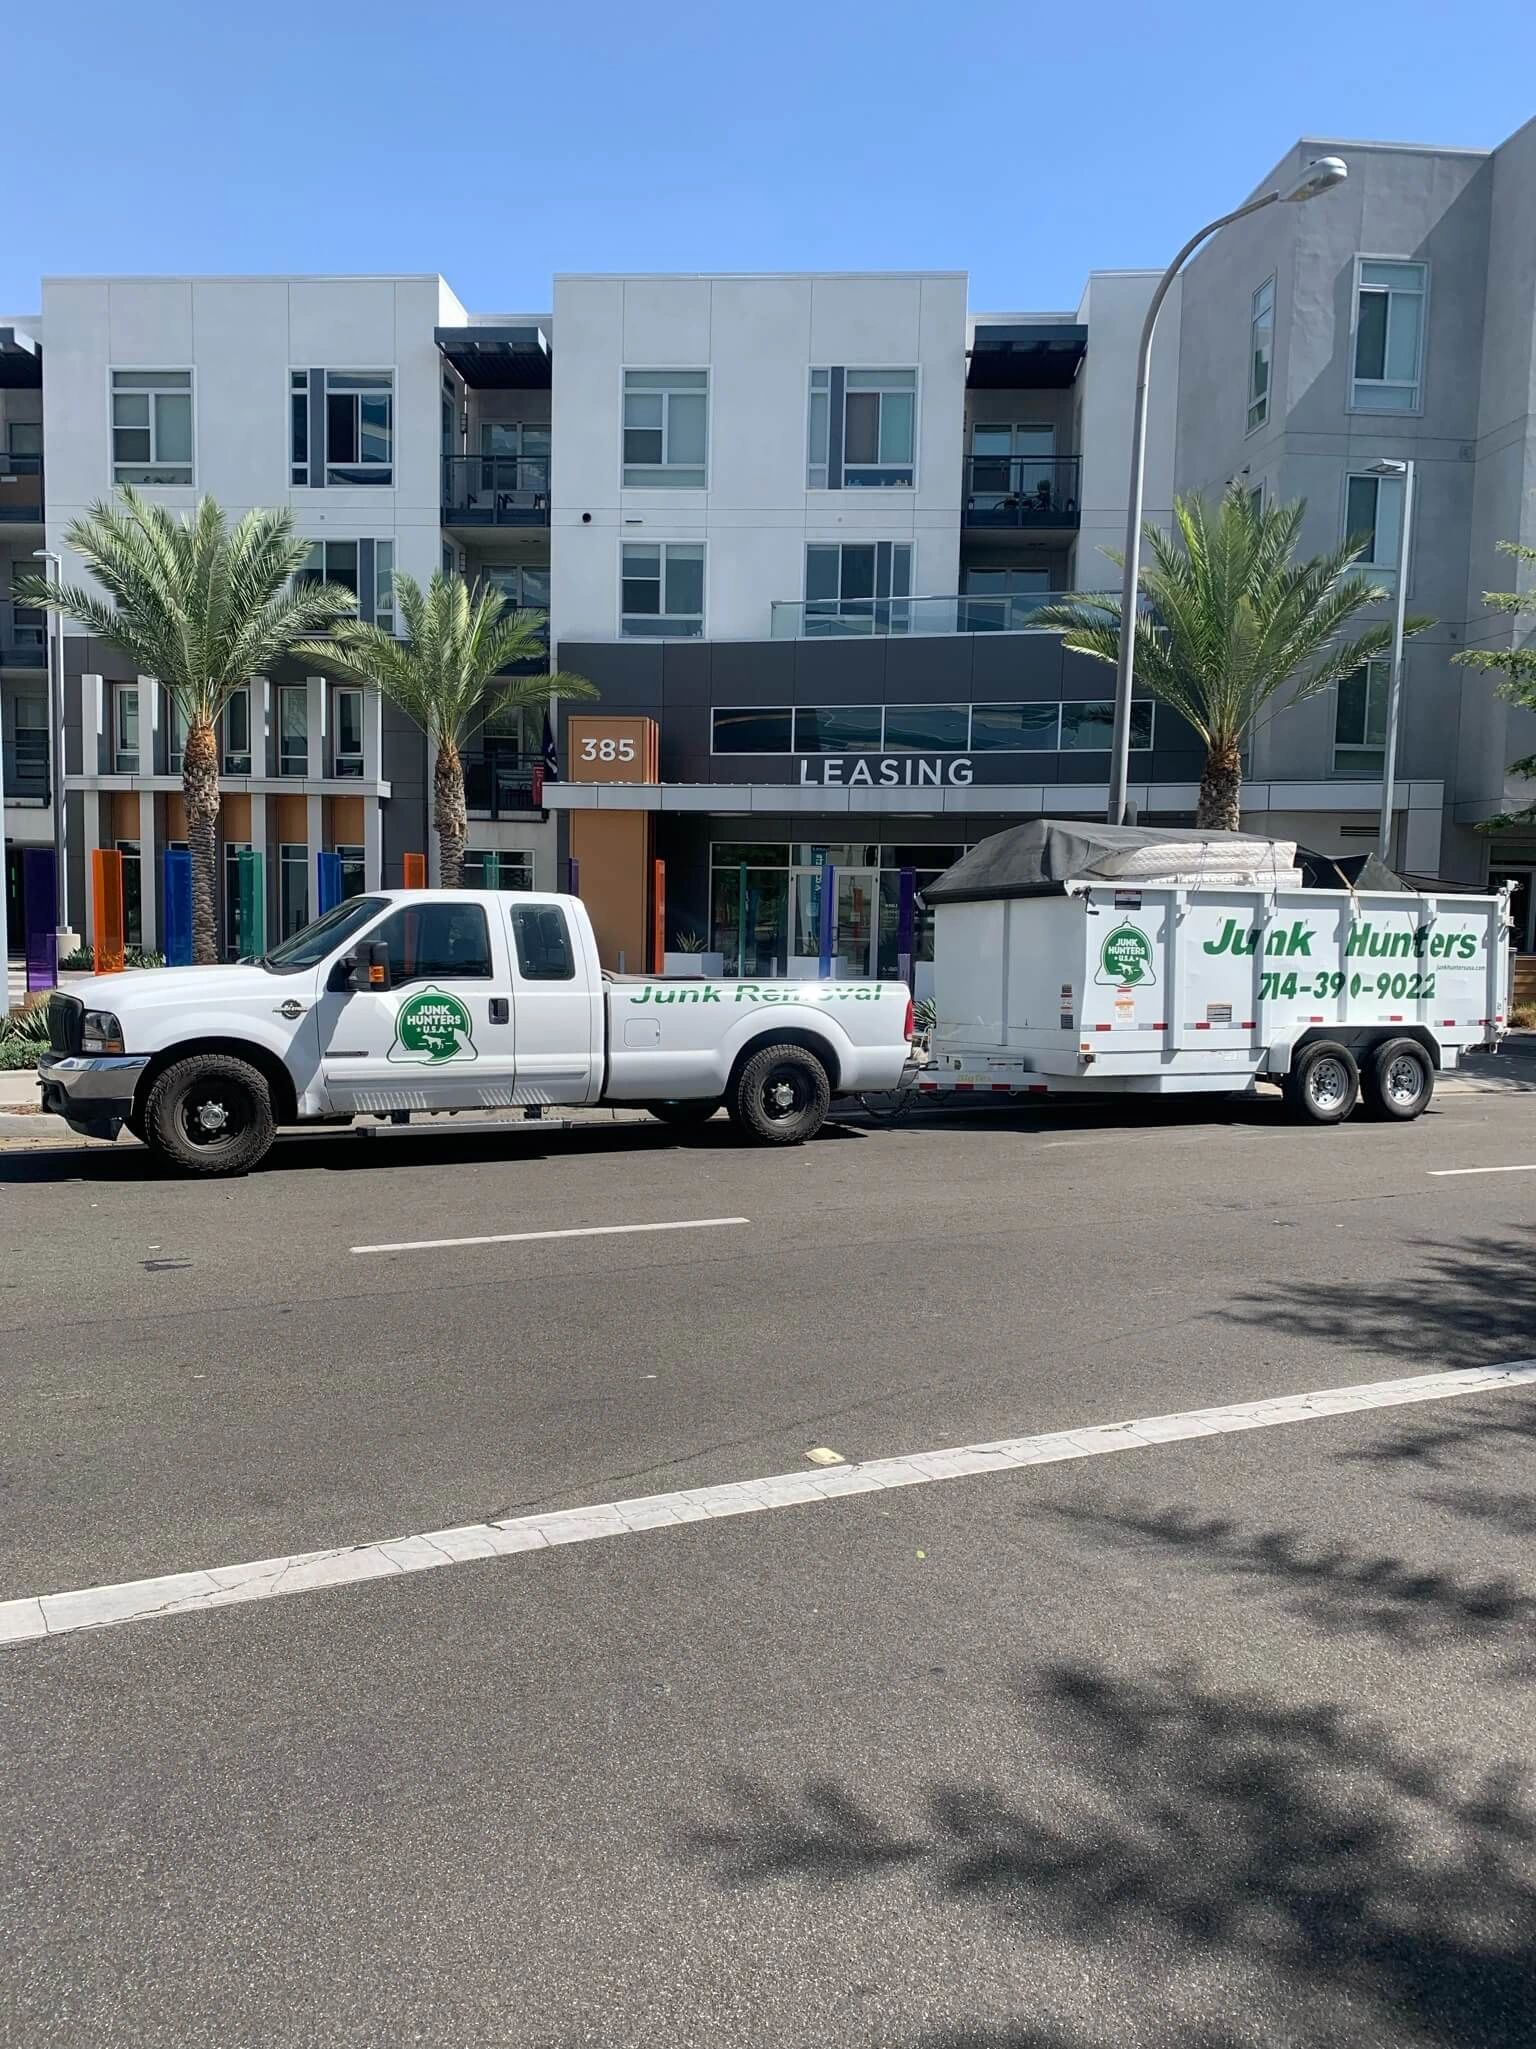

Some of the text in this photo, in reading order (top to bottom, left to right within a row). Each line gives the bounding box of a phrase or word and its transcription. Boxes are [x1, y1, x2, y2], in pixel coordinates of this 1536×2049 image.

[580, 738, 635, 761] 385
[800, 758, 973, 785] LEASING
[1115, 938, 1138, 947] JUNK
[1203, 919, 1477, 959] Junk Hunters
[1107, 946, 1145, 955] HUNTERS
[630, 985, 722, 1004] Junk
[417, 1004, 451, 1015] JUNK
[406, 1015, 462, 1026] HUNTERS
[422, 1025, 447, 1033] U.S.A.
